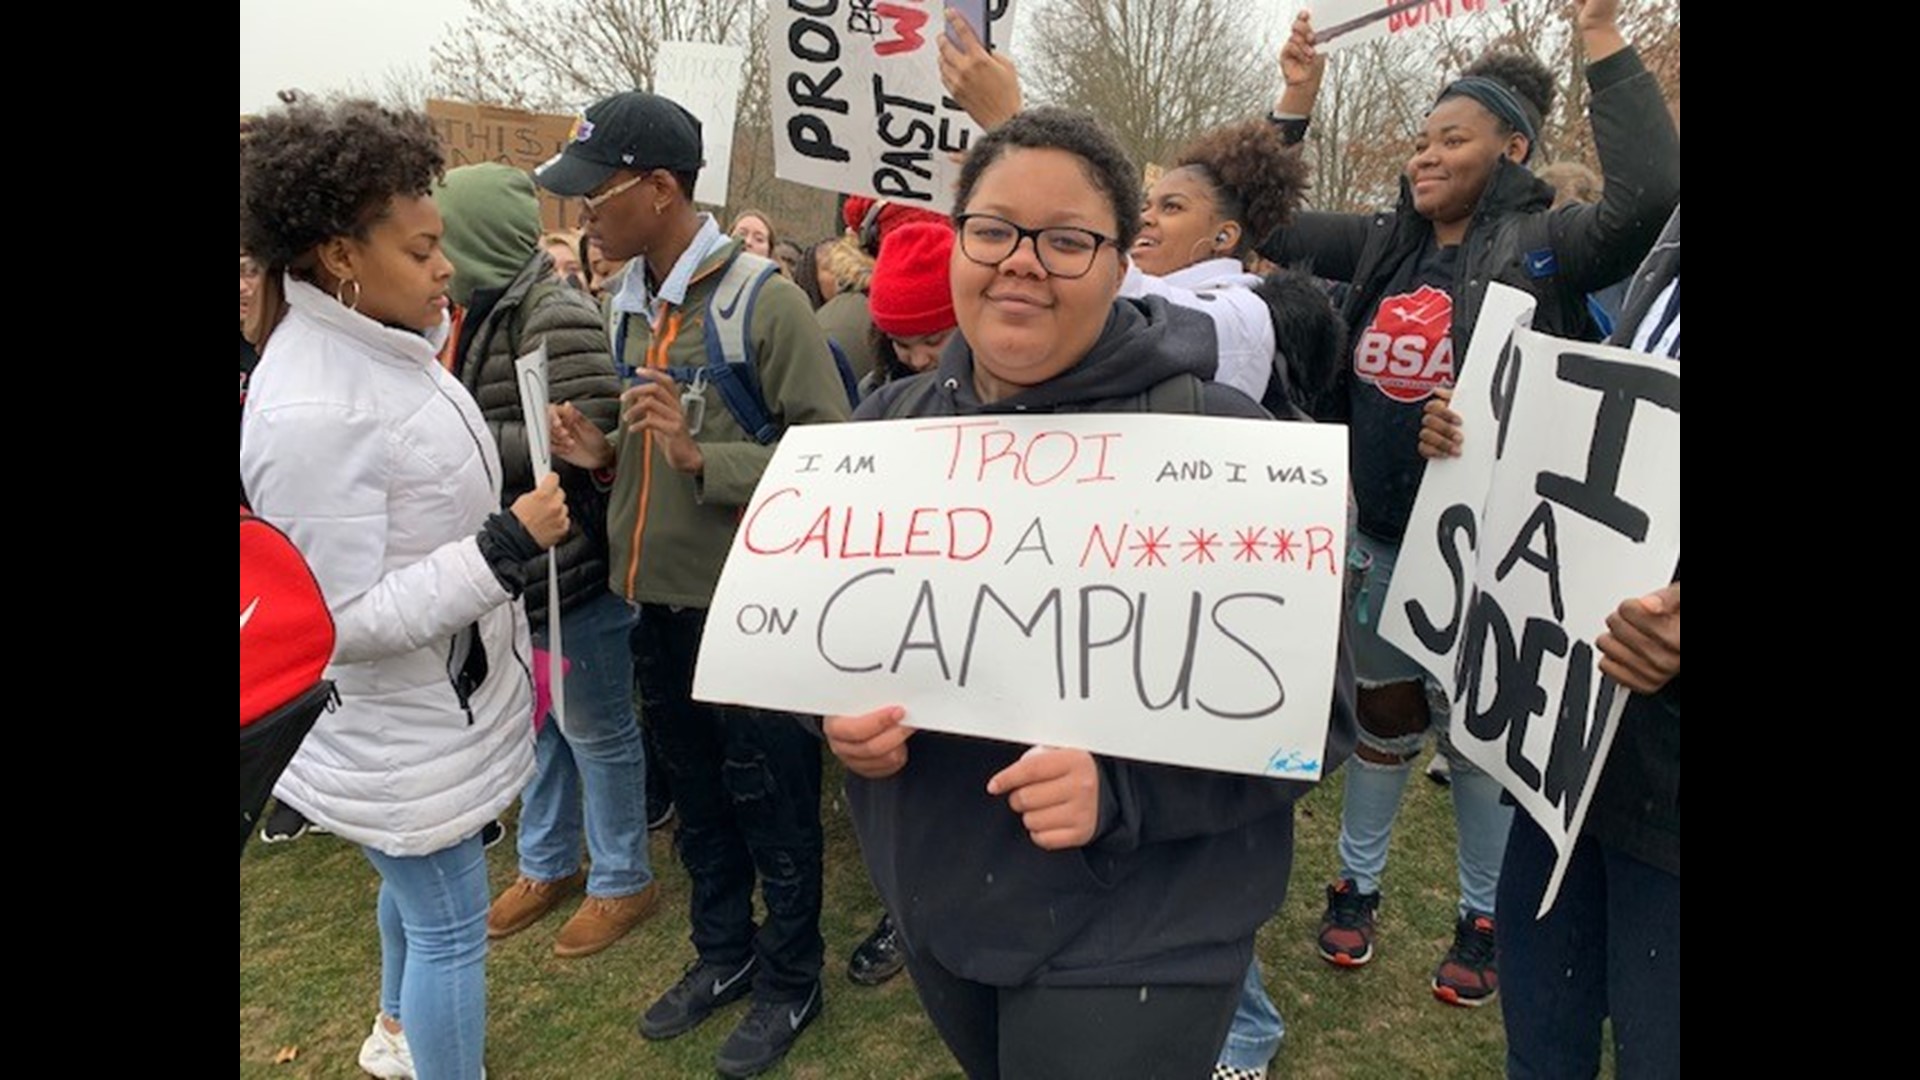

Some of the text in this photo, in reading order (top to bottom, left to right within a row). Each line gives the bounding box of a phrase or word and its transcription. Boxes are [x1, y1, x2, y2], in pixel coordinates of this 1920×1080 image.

[445, 118, 544, 156] THIS
[873, 73, 936, 202] PAST
[1357, 332, 1455, 381] BSA
[795, 421, 1330, 487] I AM TROI AND I WAS
[743, 488, 994, 561] CALLED
[1004, 516, 1055, 566] A
[1497, 500, 1563, 622] A
[736, 567, 1287, 720] ON CAMPUS
